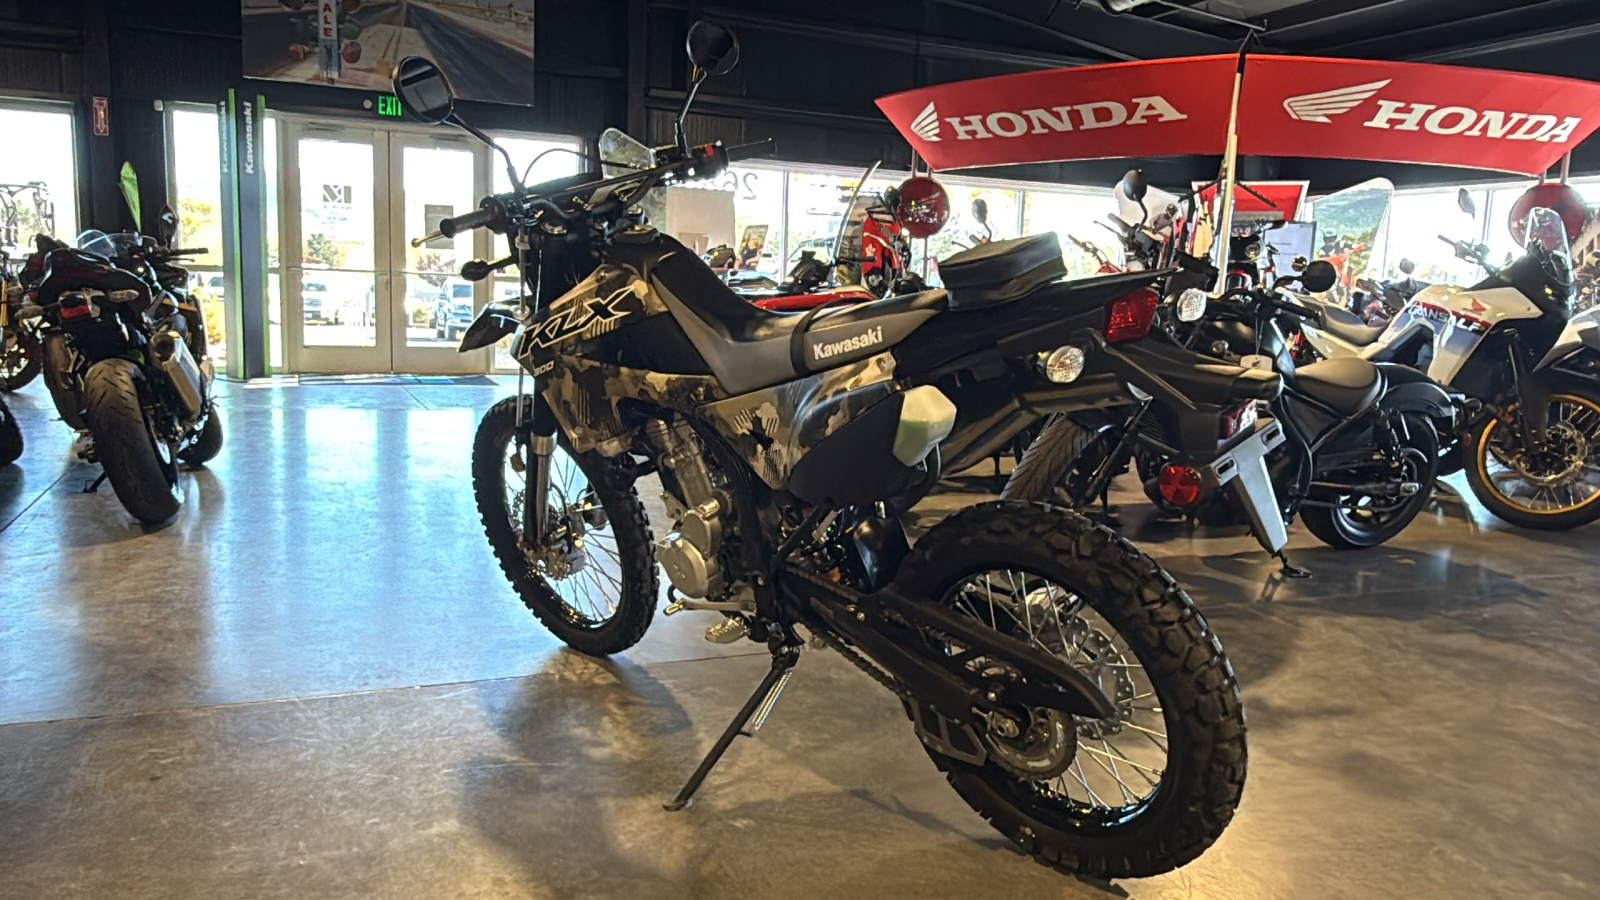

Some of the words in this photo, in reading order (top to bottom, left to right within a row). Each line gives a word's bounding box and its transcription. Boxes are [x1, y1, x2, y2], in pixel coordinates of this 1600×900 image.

[243, 101, 254, 174] Kawasaki
[945, 95, 1187, 139] HONDA
[1363, 99, 1581, 143] HONDA
[518, 284, 636, 359] KLX
[813, 325, 883, 360] Kawasaki
[533, 360, 554, 377] 300
